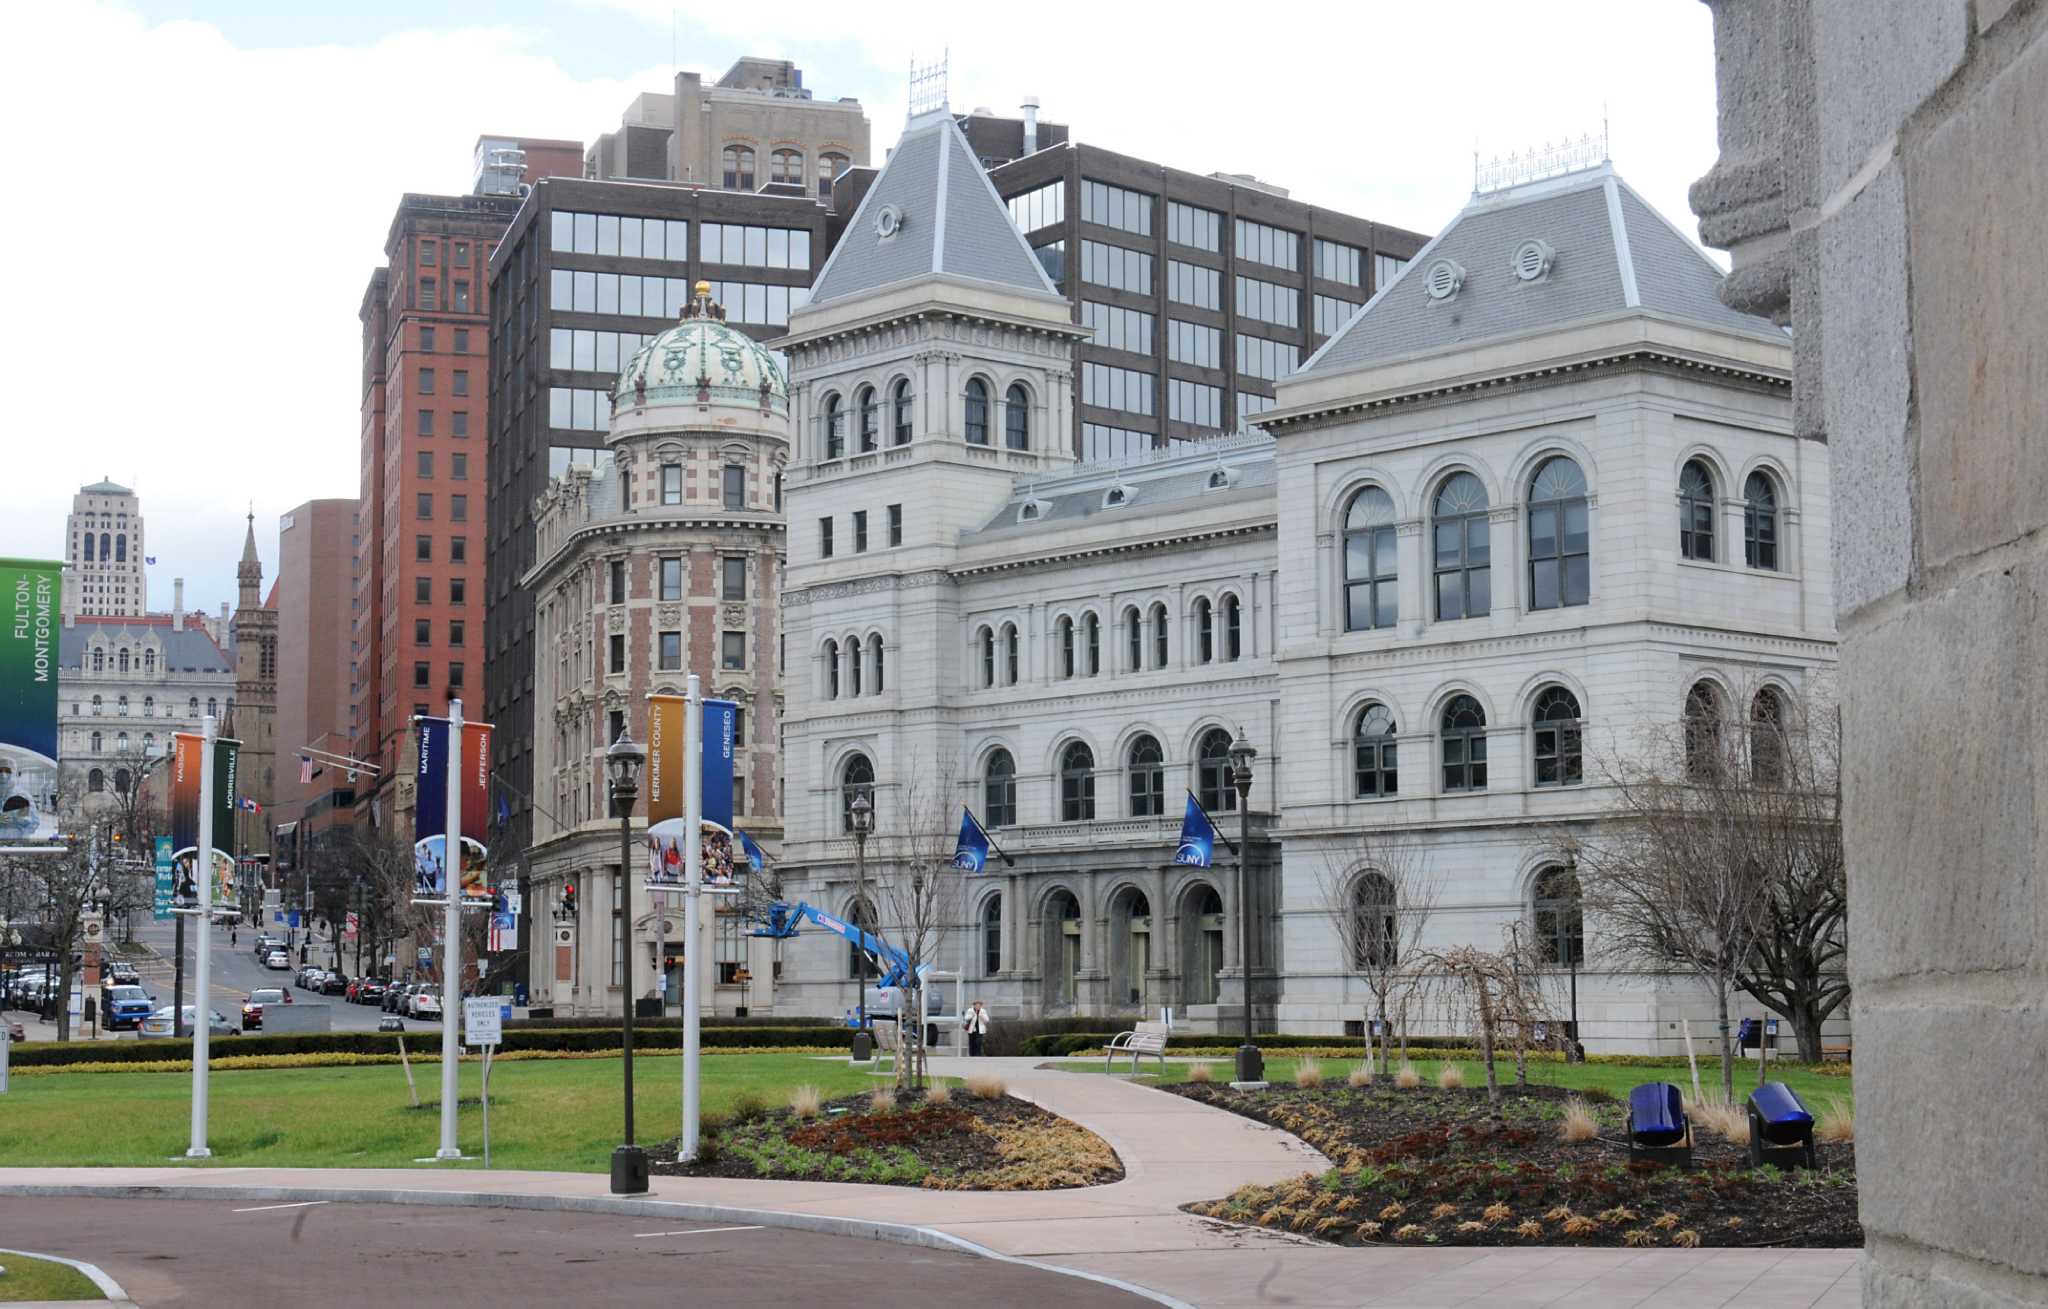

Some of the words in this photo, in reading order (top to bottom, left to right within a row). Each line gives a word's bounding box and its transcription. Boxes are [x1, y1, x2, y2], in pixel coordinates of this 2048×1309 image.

[15, 574, 30, 639] FULTON-
[34, 574, 51, 682] MONTGOMERY
[420, 726, 430, 774] MARITIME
[652, 704, 662, 748] COUNTY
[723, 710, 731, 759] GENESEO
[177, 743, 185, 783] NASSAU
[226, 749, 236, 809] MORRISVILLE
[479, 733, 488, 790] JEFFERSON
[652, 750, 661, 802] HERKIMER
[1176, 852, 1200, 865] SUNY
